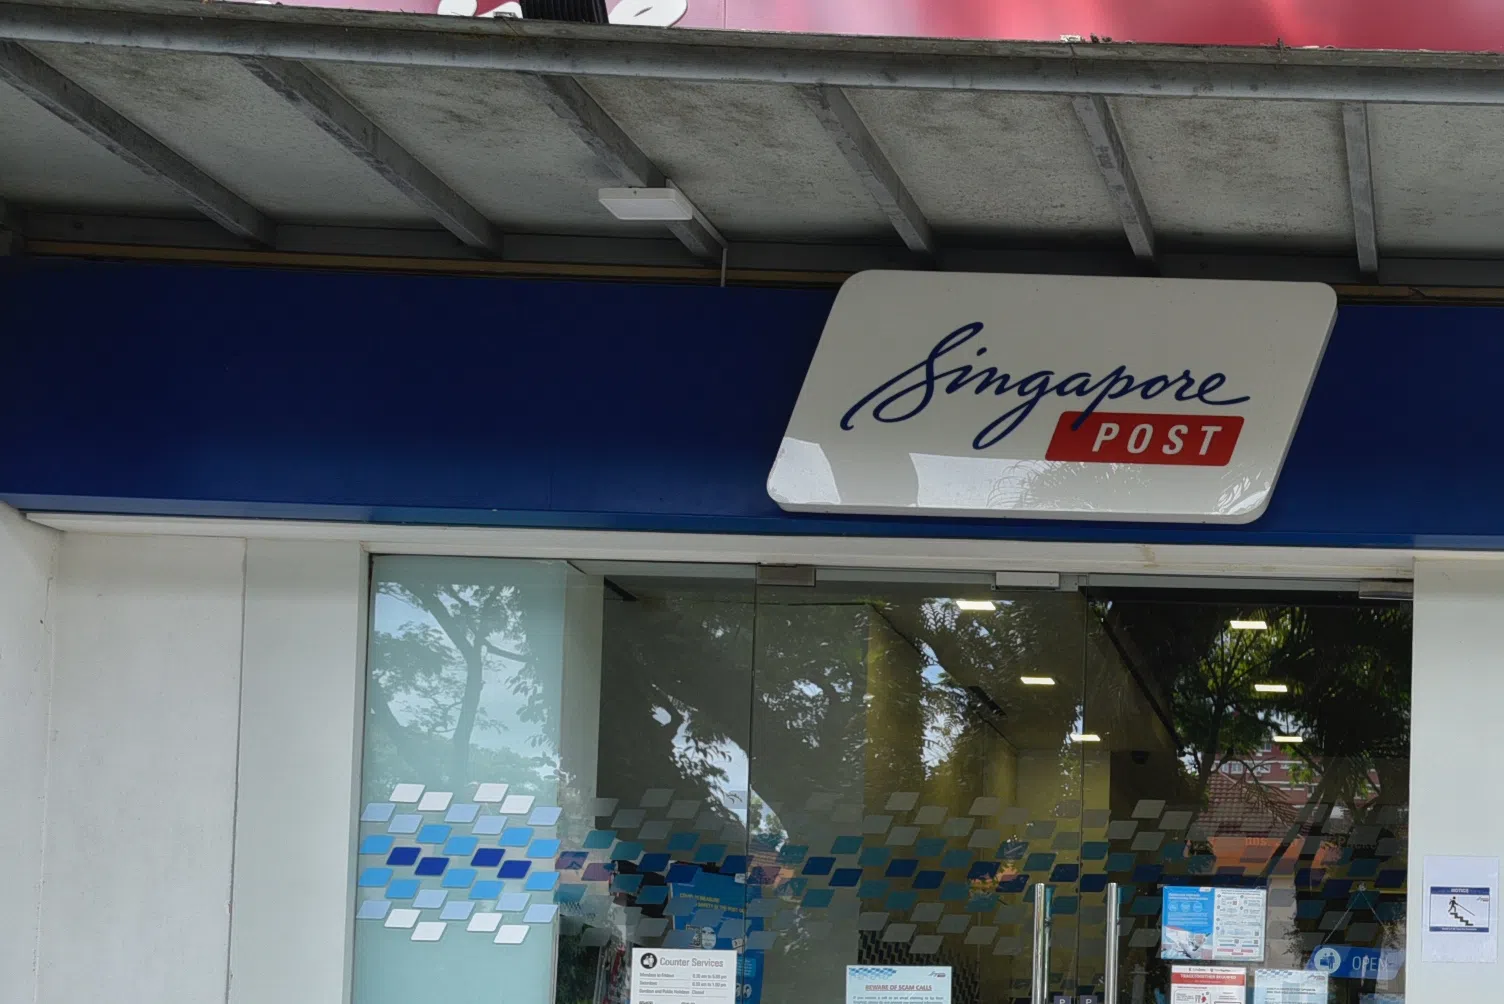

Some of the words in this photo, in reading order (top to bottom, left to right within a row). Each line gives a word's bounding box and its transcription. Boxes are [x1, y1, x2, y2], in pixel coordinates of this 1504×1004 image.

[839, 320, 1250, 450] Singapore
[1092, 421, 1222, 456] POST
[660, 958, 690, 967] Counter
[692, 958, 724, 968] Services
